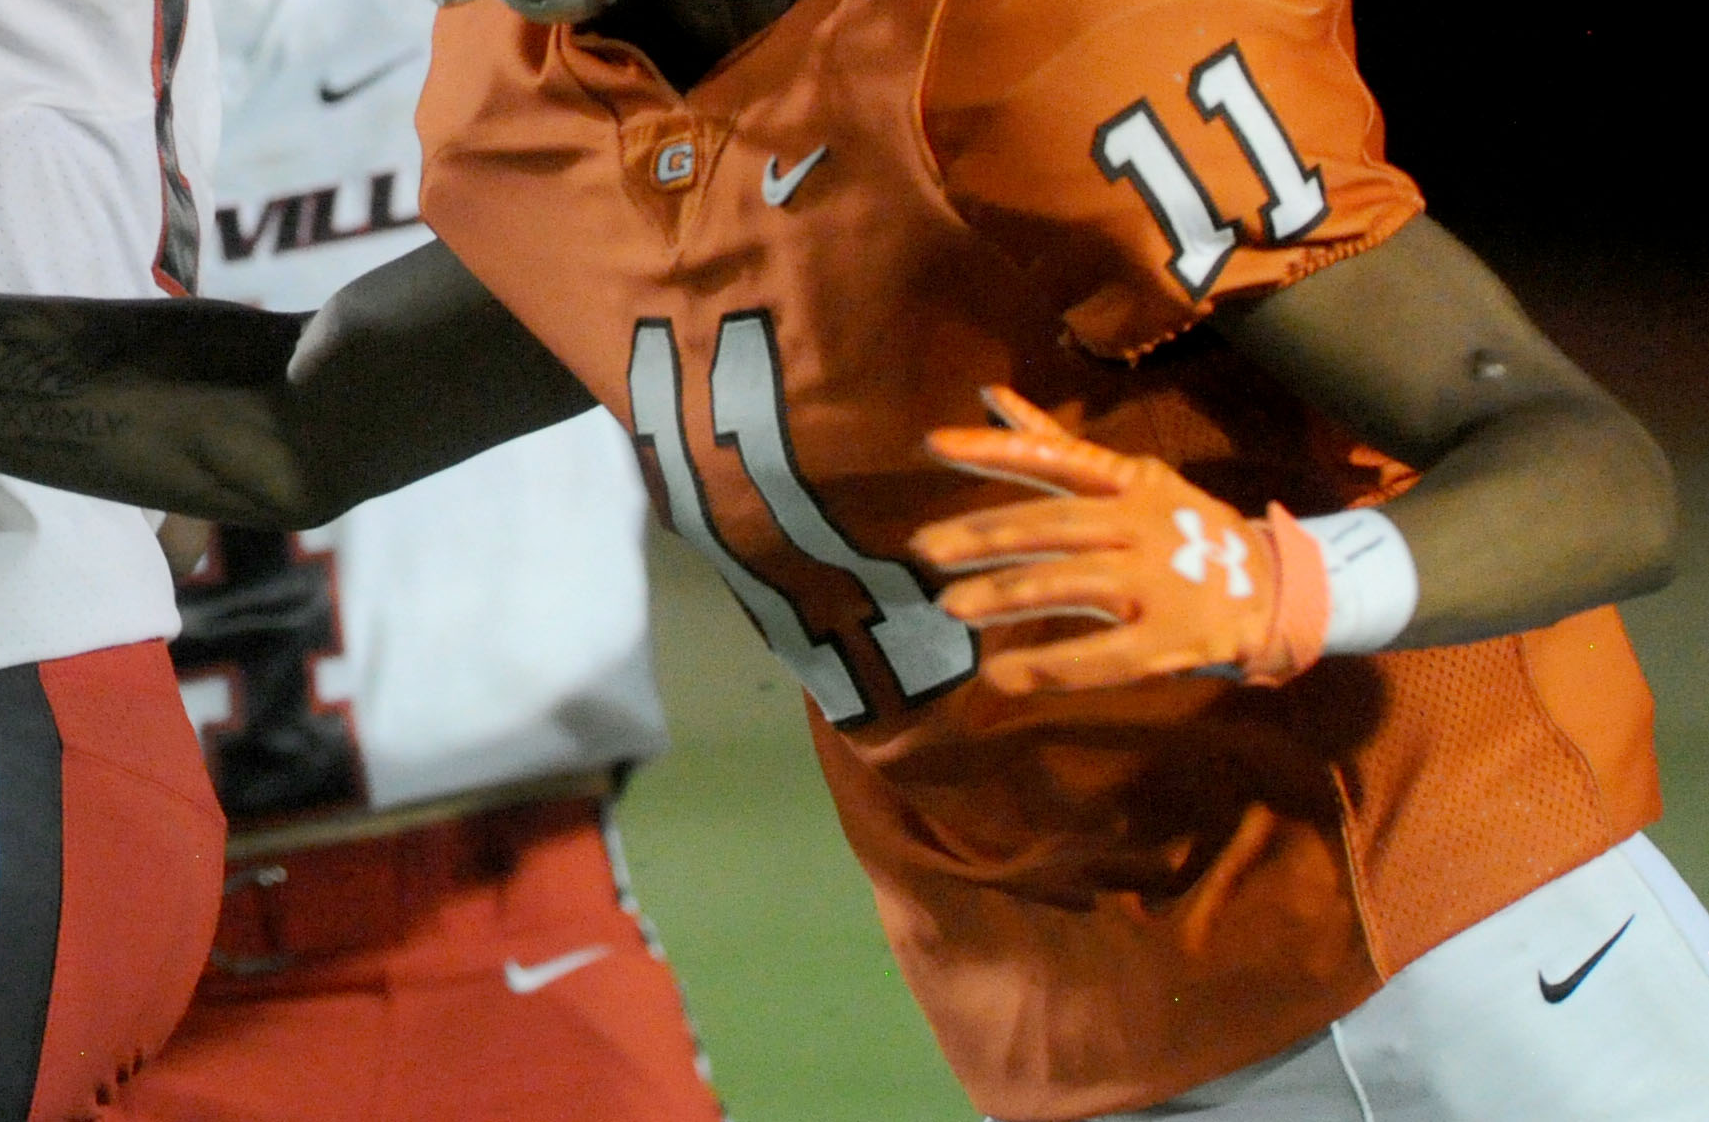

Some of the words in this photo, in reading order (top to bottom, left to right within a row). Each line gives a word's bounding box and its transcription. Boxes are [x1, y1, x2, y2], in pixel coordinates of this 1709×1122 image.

[656, 142, 695, 186] G
[1092, 39, 1330, 301] 11
[626, 306, 980, 730] 11
